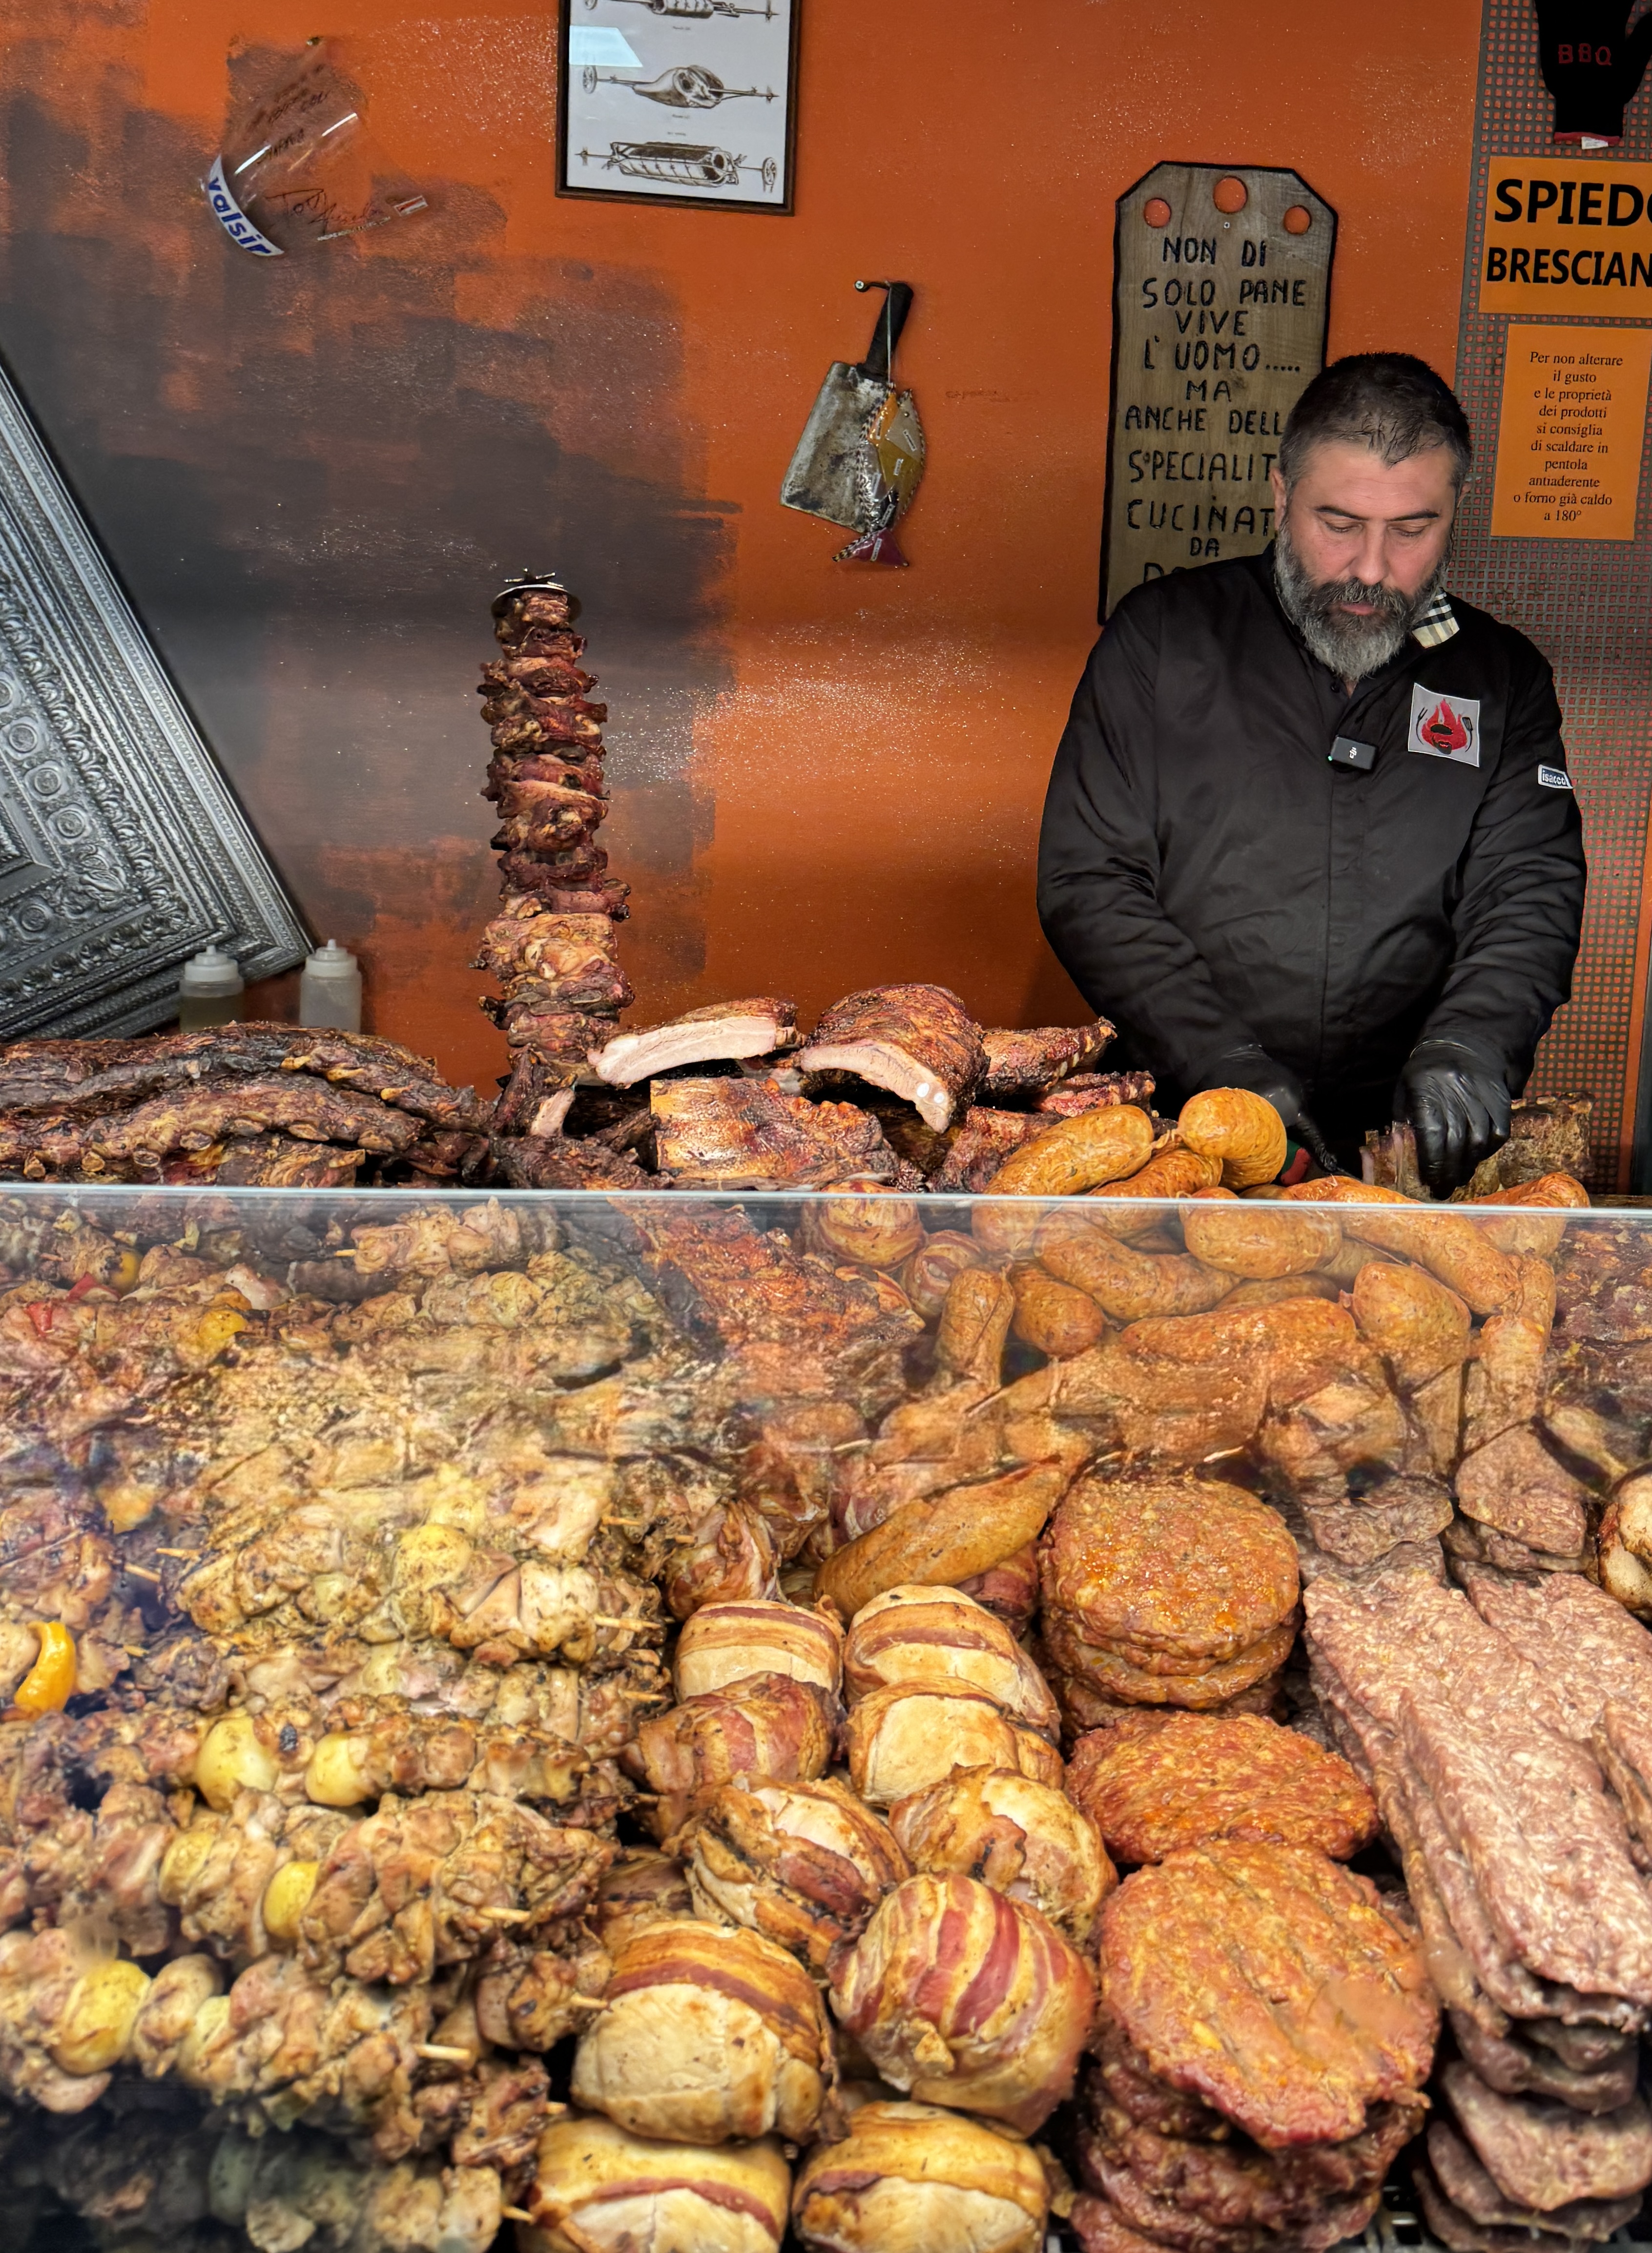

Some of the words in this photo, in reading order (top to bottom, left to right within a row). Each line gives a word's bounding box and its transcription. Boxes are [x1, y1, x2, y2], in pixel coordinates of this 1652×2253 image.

[1558, 43, 1611, 65] BBQ
[1494, 178, 1652, 227] SPIED
[208, 176, 272, 254] valsir
[1162, 236, 1217, 265] NON
[1241, 240, 1267, 267] DI
[1487, 247, 1652, 287] BRESCIAN
[1142, 277, 1216, 309] SOLO
[1239, 279, 1307, 306] PANE
[1175, 310, 1248, 336] VIVE
[1529, 351, 1550, 364] Per
[1553, 355, 1575, 364] non
[1578, 353, 1623, 366] alterare
[1553, 370, 1561, 382] il
[1564, 373, 1597, 385] gusto
[1185, 379, 1232, 402] MA
[1534, 390, 1541, 399] e
[1545, 387, 1555, 399] le
[1558, 389, 1611, 403] proprietà
[1125, 405, 1207, 431] ANCHE
[1229, 409, 1285, 436] DELL
[1539, 404, 1557, 416] dei
[1560, 406, 1607, 420] prodotti
[1536, 422, 1547, 434] si
[1549, 423, 1603, 438] consiglia
[1530, 439, 1542, 451] di
[1546, 440, 1594, 453] scaldare
[1597, 441, 1608, 454] in
[1129, 449, 1278, 483] SPECIALIT
[1545, 458, 1588, 472] pentola
[1528, 475, 1600, 488] antiaderente
[1513, 495, 1521, 503] o
[1525, 491, 1556, 504] forno
[1559, 493, 1577, 507] già
[1580, 494, 1612, 505] caldo
[1127, 498, 1276, 537] CUCINAT
[1544, 513, 1550, 521] a
[1190, 537, 1219, 557] DA
